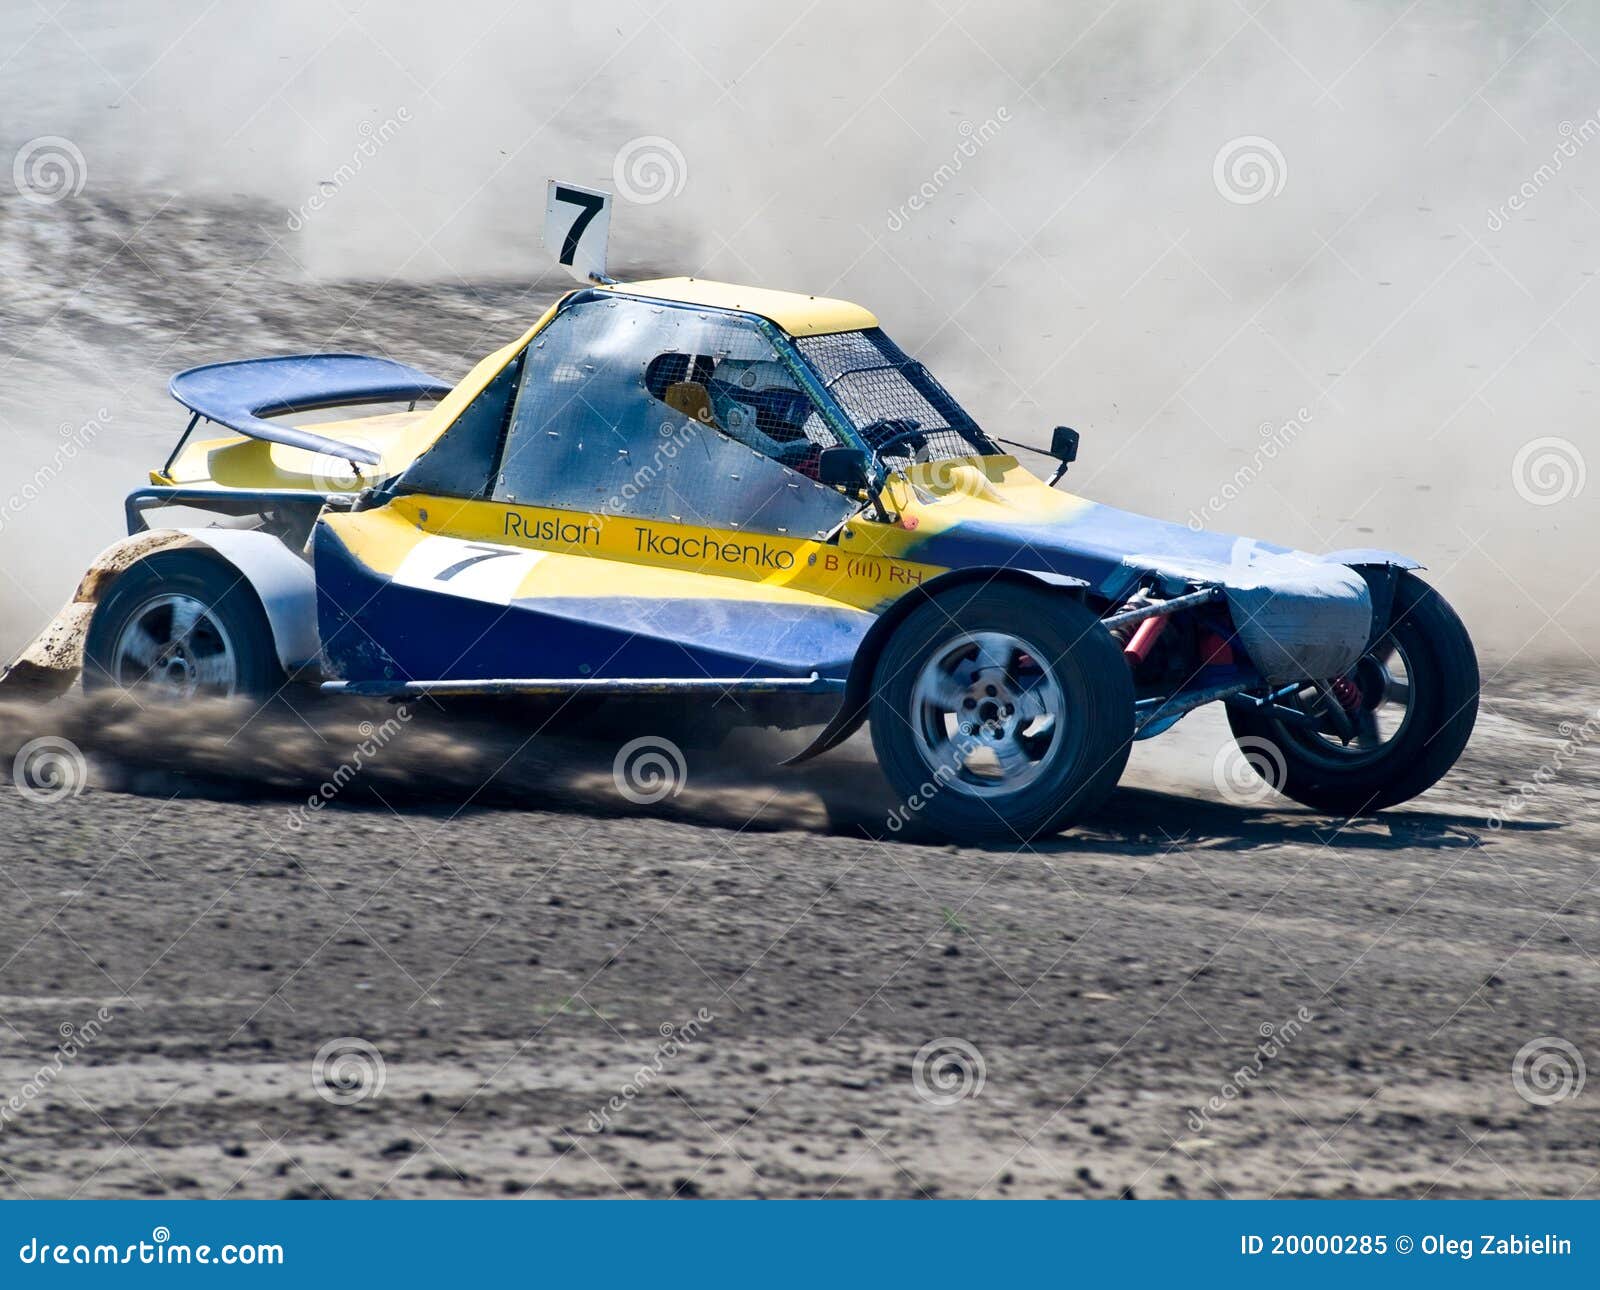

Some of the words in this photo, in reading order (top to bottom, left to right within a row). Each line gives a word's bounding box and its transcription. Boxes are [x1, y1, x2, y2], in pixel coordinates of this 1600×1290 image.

[555, 186, 604, 266] 7
[433, 545, 523, 582] 7
[504, 511, 600, 545] Ruslan
[634, 527, 795, 571] Tkachenko
[824, 554, 839, 572] B
[889, 566, 923, 585] RH
